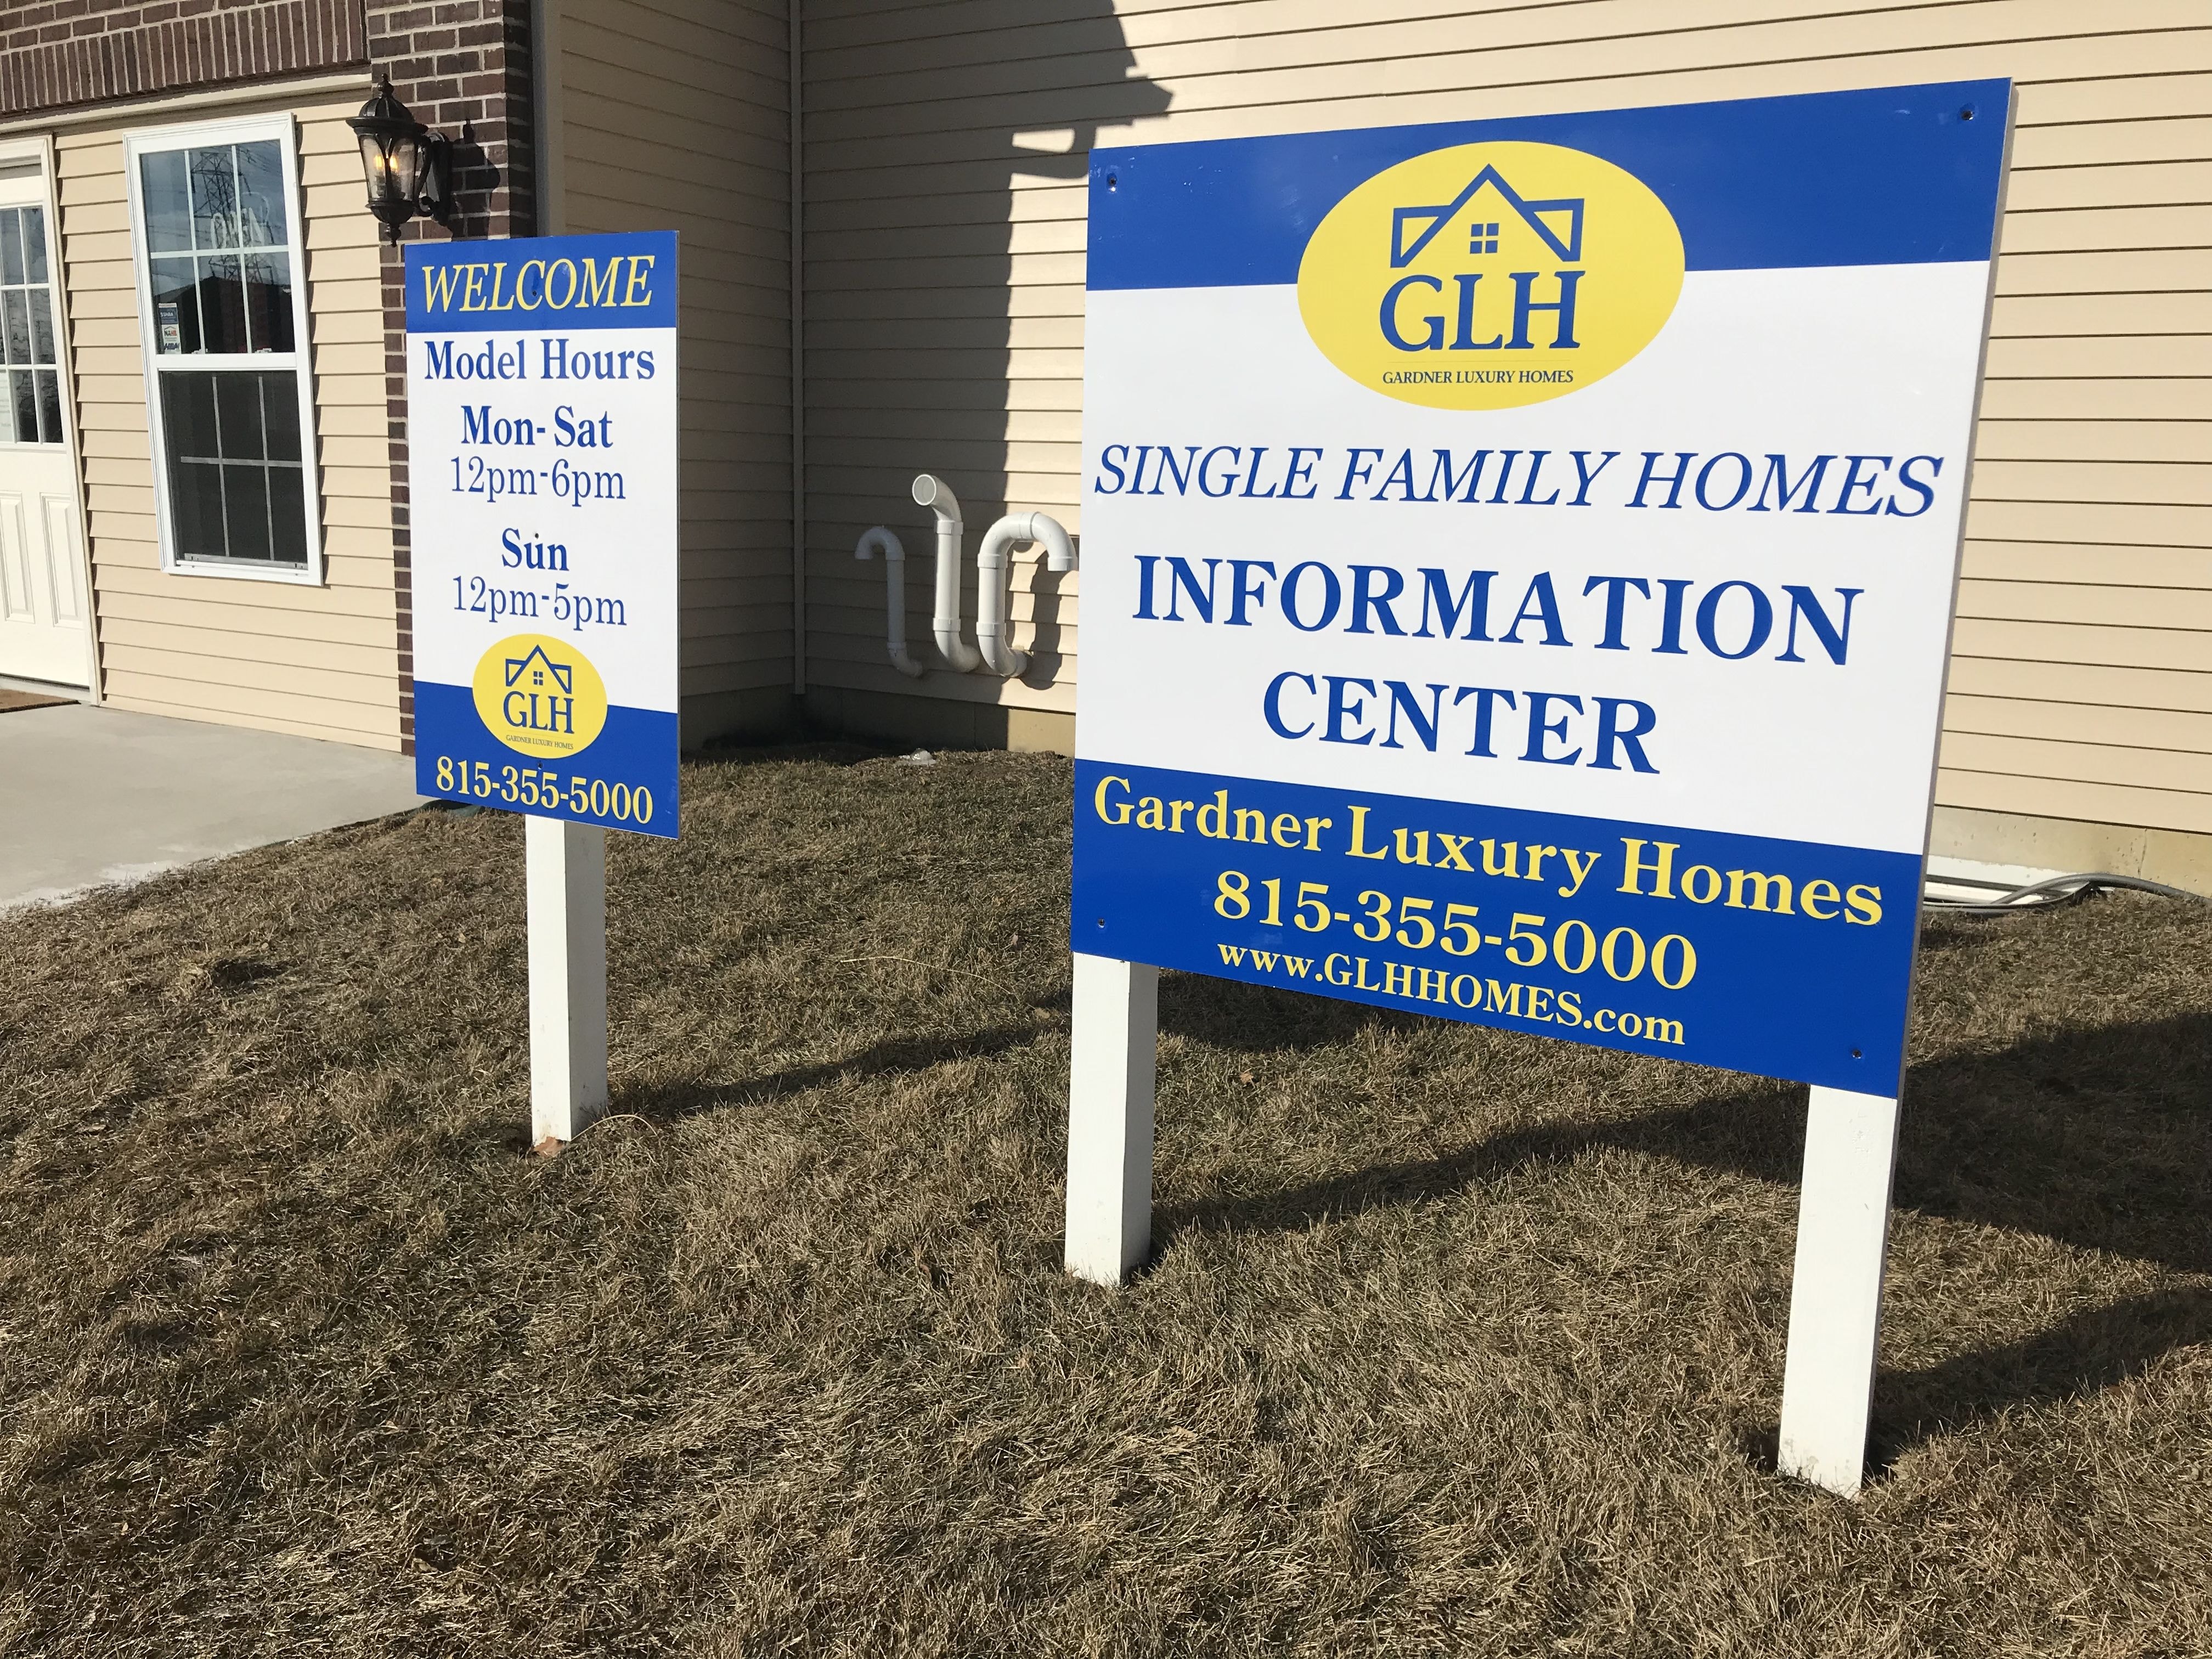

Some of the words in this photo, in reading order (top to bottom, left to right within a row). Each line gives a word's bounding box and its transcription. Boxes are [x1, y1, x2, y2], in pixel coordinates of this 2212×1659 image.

[422, 255, 655, 313] WELCOME
[1379, 270, 1585, 352] GLH
[425, 338, 526, 381] Model
[540, 337, 656, 381] Hours
[1382, 370, 1453, 385] GARDNER
[1455, 370, 1516, 384] LUXURY
[1517, 369, 1574, 383] HOMES
[554, 405, 613, 449] Sat
[452, 456, 625, 508] 12pm-6pm
[1094, 443, 1324, 500] SINGLE
[1334, 447, 1621, 507] FAMILY
[1625, 451, 1944, 518] HOMES
[501, 527, 568, 572] Sun
[453, 575, 627, 631] 12pm-5pm
[1132, 554, 1865, 666] INFORMATION
[503, 690, 574, 734] GLH
[1262, 670, 1660, 775] CENTER
[506, 735, 532, 744] GARDNER
[532, 738, 553, 747] LUXURY
[554, 741, 574, 750] HOMES
[436, 756, 653, 824] 815-355-5000
[1094, 776, 1333, 851] Gardner
[1346, 805, 1601, 898] Luxury
[1617, 837, 1882, 926] Homes
[1214, 870, 1697, 990] 815-355-5000
[1217, 943, 1685, 1045] www.GLHHOMES.com
